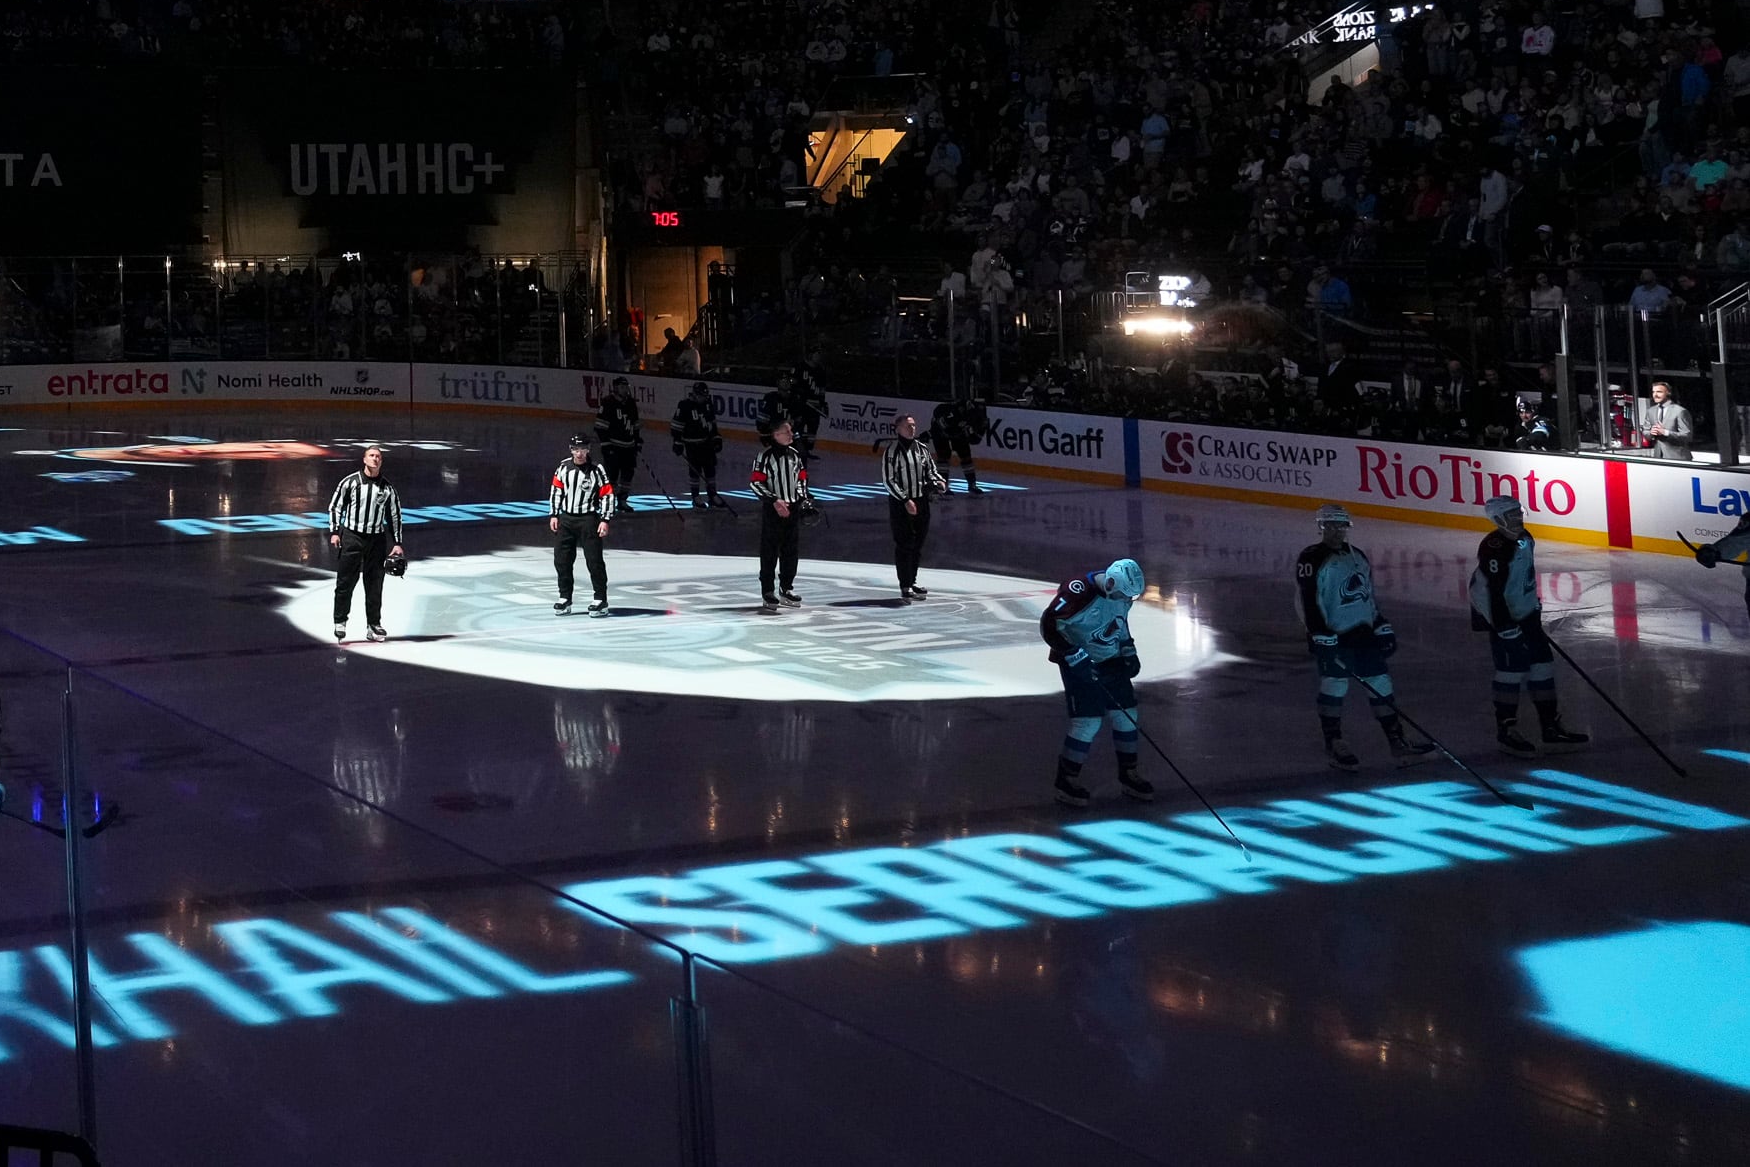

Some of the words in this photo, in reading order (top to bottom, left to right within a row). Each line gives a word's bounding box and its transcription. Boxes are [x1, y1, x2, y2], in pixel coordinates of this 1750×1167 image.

[652, 212, 679, 226] 7:05
[47, 368, 169, 396] entrata
[217, 374, 262, 388] Nomi
[268, 372, 324, 388] Health
[438, 370, 543, 404] trüfrü
[829, 416, 878, 434] AMERICA
[986, 418, 1034, 452] Ken
[1038, 422, 1104, 459] Garff
[1197, 434, 1261, 461] CRAIG
[1266, 440, 1337, 468] SWAPP
[1198, 461, 1211, 477] &
[1213, 463, 1313, 488] ASSOCIATES
[1296, 562, 1314, 578] 20
[1488, 558, 1500, 574] 8
[559, 769, 1747, 965] SERGACHEV
